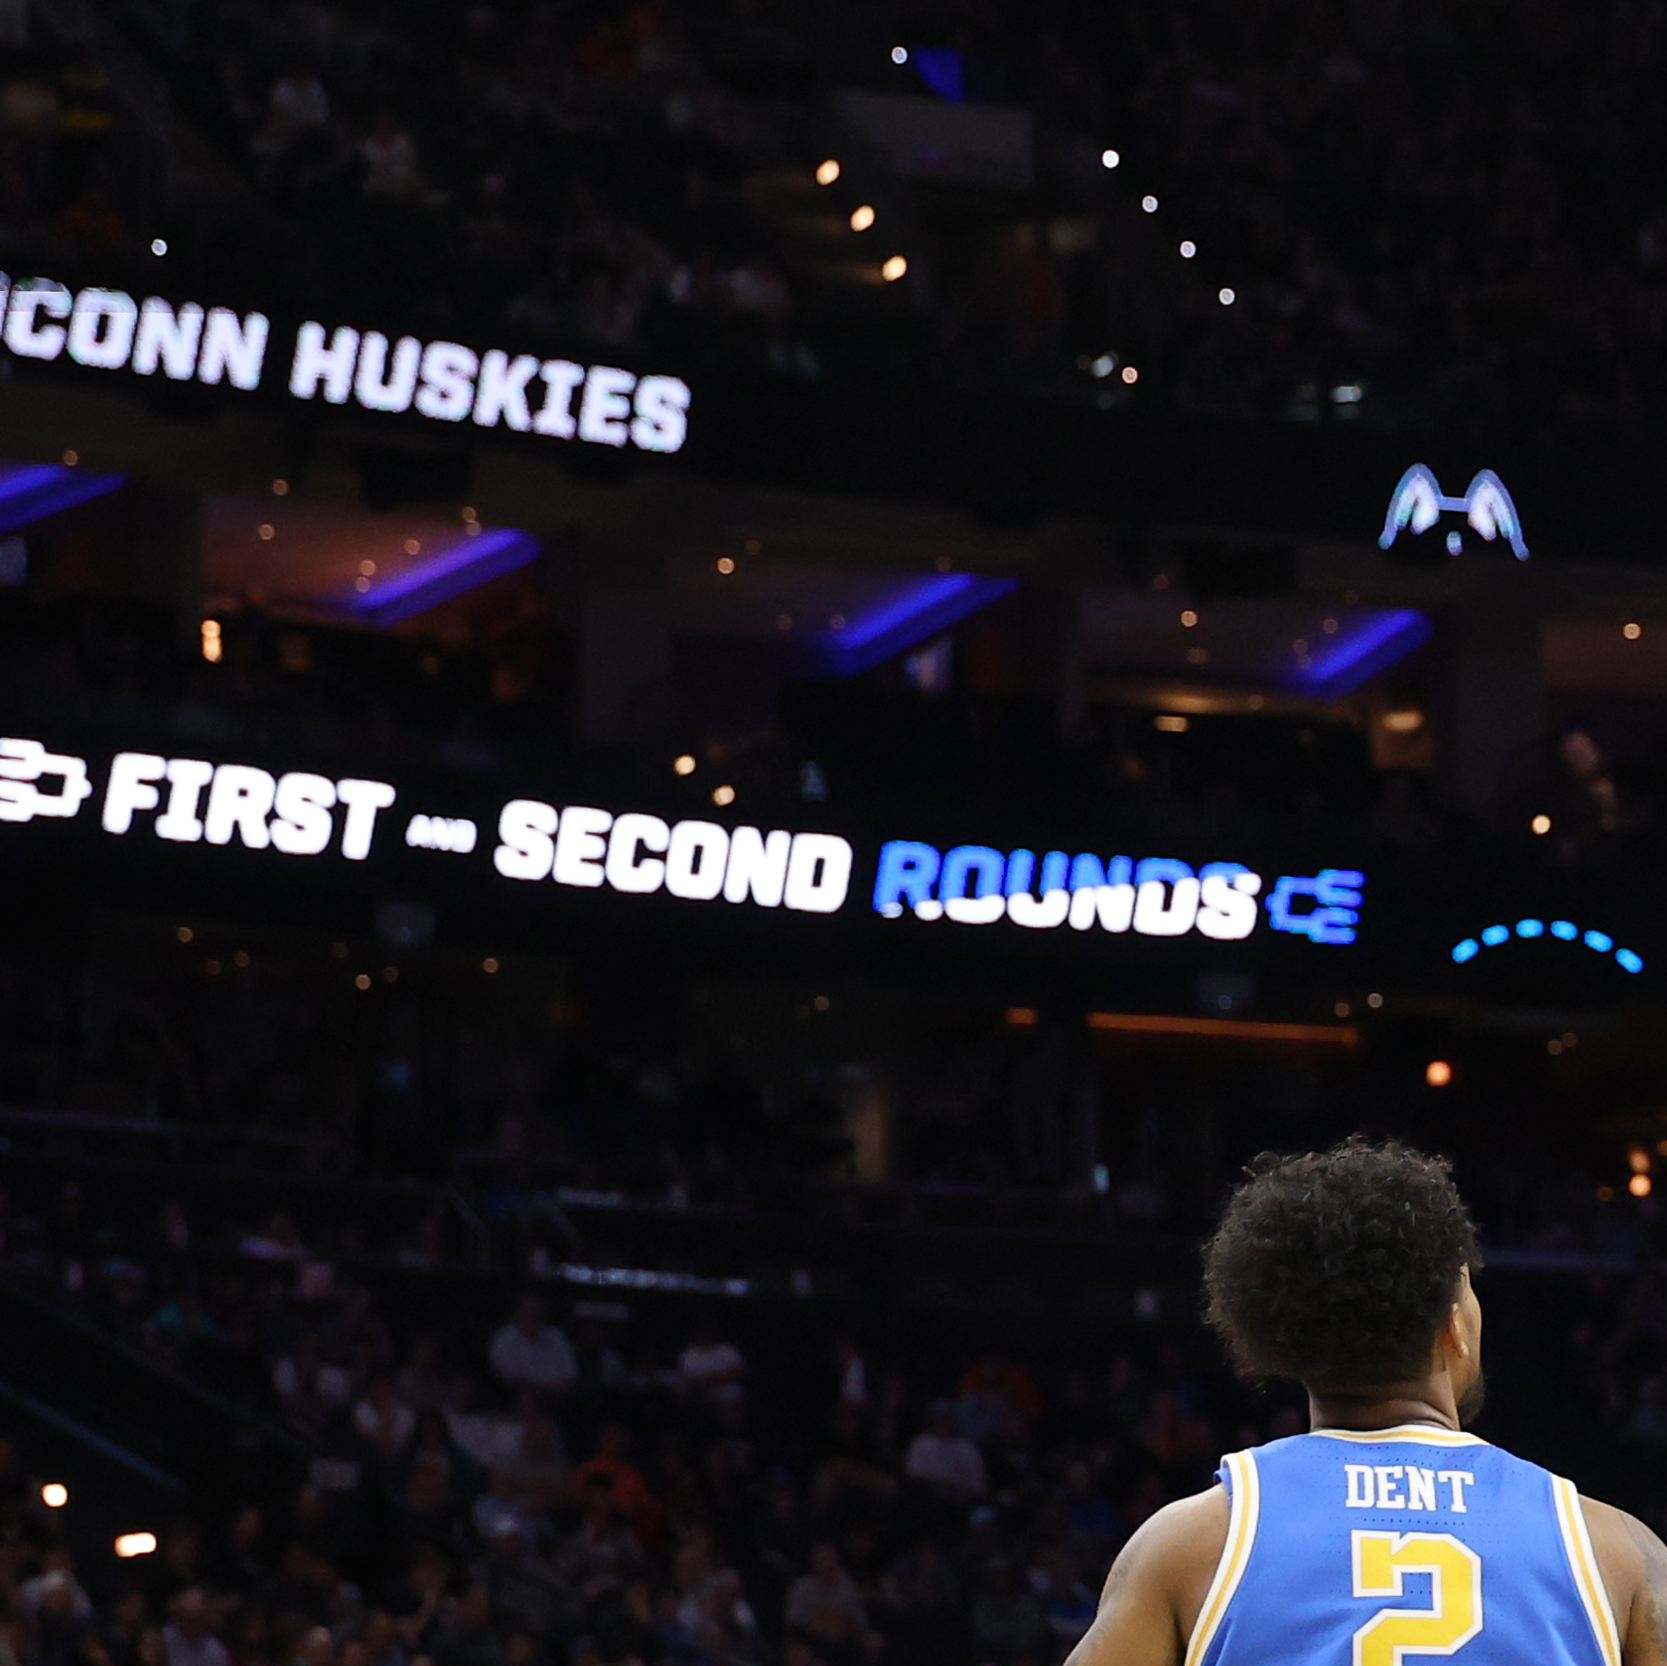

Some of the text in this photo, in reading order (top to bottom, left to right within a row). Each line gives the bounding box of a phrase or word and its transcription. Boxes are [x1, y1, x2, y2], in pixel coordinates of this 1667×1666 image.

[0, 271, 691, 453] CONN HUSKIES
[102, 752, 1262, 940] FIRST AND SECOND ROUNDS
[1344, 1464, 1475, 1514] DENT
